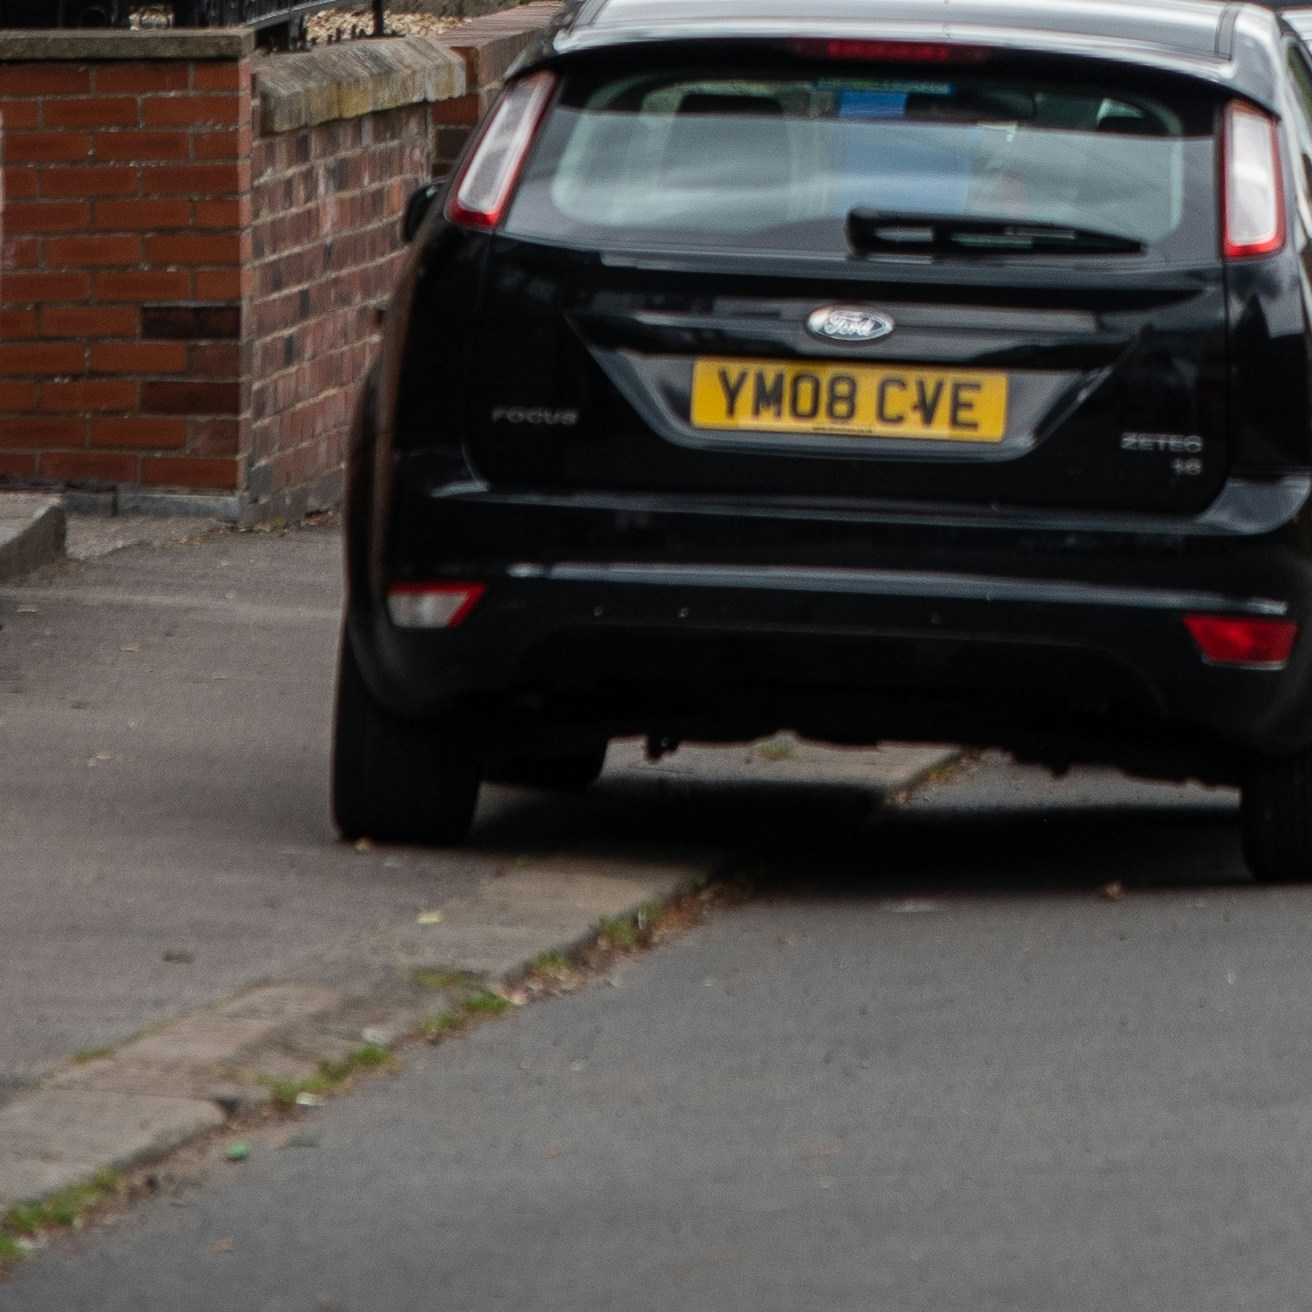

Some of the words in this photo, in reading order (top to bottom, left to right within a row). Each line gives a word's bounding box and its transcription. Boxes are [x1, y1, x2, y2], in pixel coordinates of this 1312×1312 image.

[717, 368, 858, 423] YM08
[876, 377, 983, 433] CVE
[491, 407, 578, 425] FOCUS
[1121, 433, 1202, 453] ZETEC
